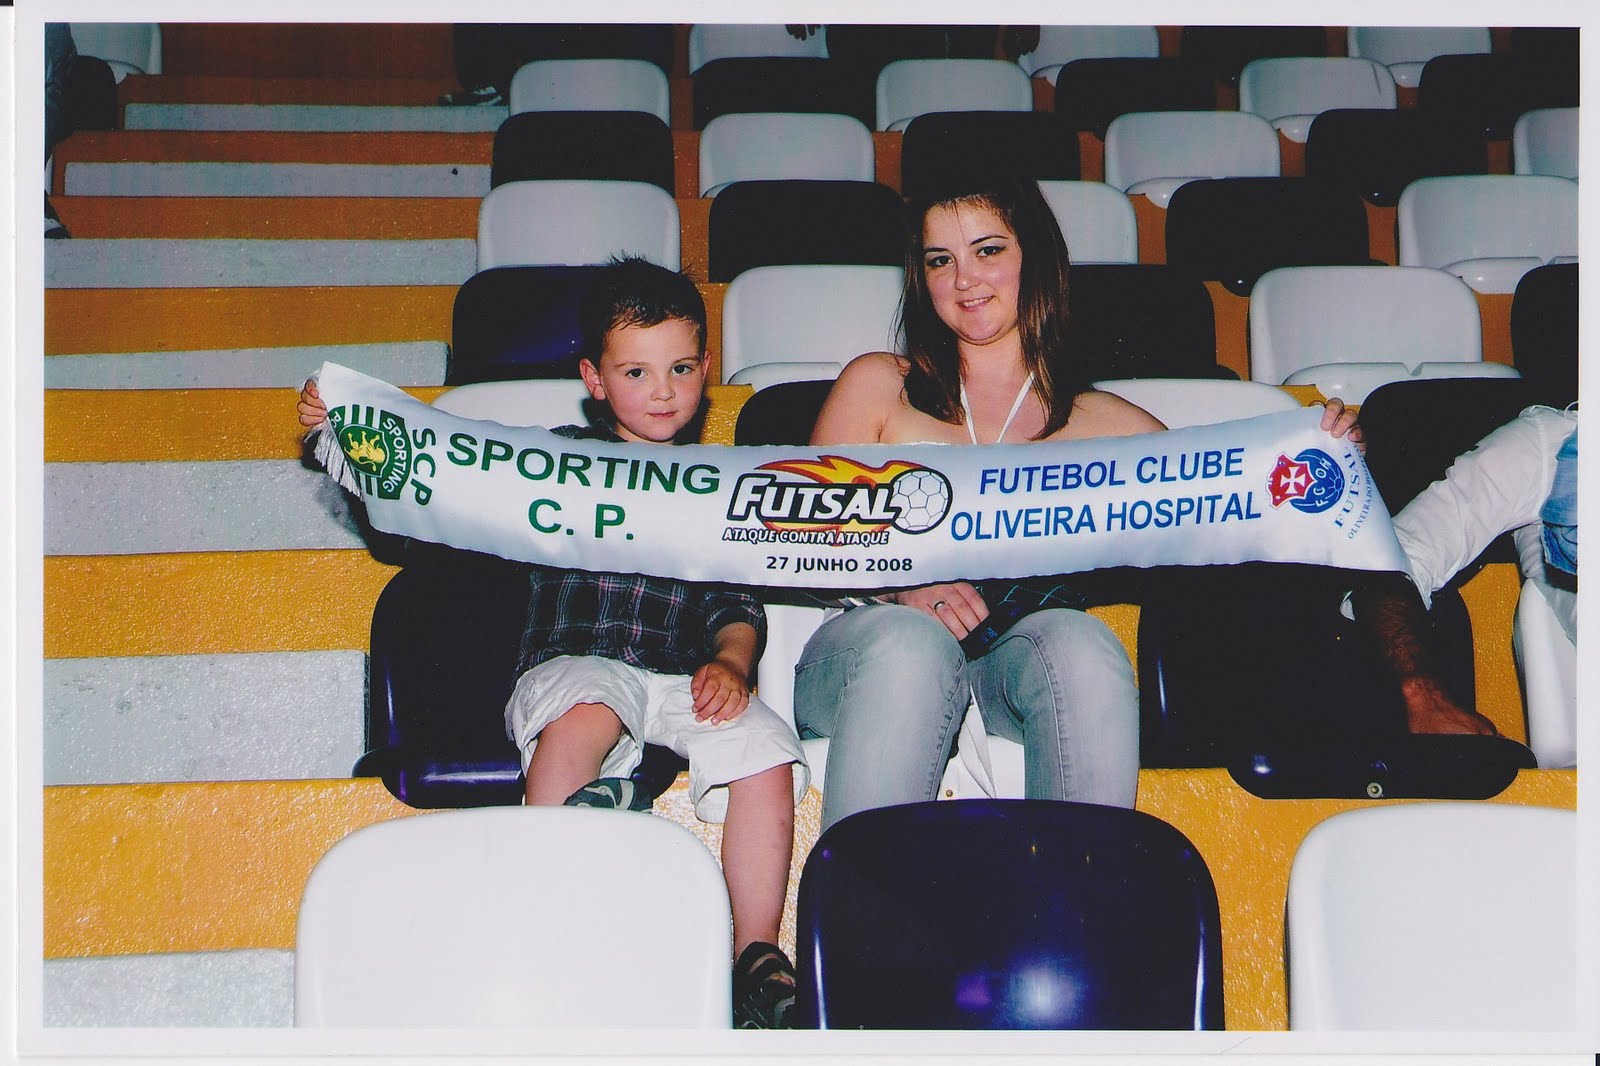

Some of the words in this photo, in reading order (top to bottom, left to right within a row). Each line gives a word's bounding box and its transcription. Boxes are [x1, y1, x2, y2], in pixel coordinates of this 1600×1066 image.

[382, 417, 406, 493] SPORTING
[410, 428, 436, 506] SCP
[446, 432, 721, 494] SPORTING
[979, 460, 1126, 495] FUTEBOL
[1136, 447, 1245, 484] CLUBE
[728, 474, 898, 522] FUTSAL
[1334, 446, 1360, 527] FUTSAL
[722, 527, 776, 545] ATAQUE
[779, 529, 836, 546] CONTRA
[834, 530, 890, 547] ATAQUE
[950, 504, 1097, 541] OLIVEIRA
[1106, 491, 1262, 532] HOSPITAL
[766, 556, 789, 570] 27
[795, 557, 858, 574] JUNHO
[865, 558, 912, 572] 2008
